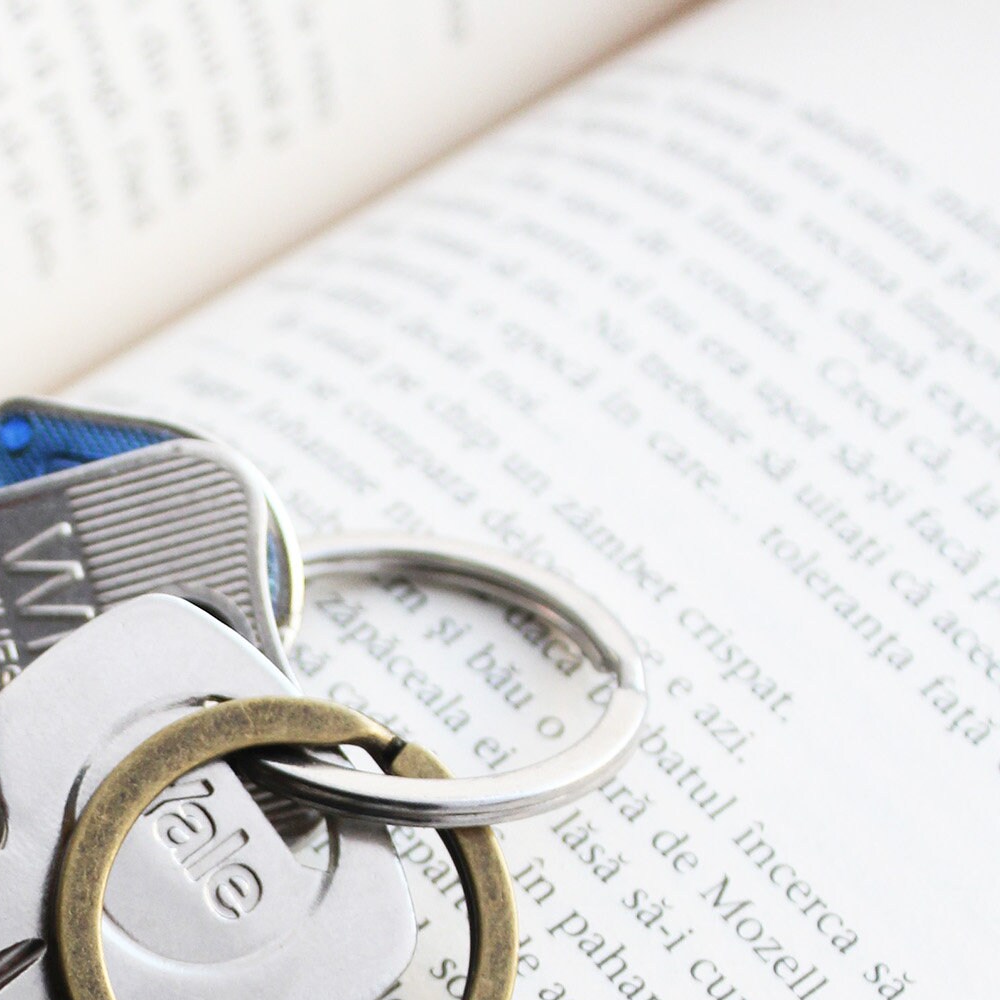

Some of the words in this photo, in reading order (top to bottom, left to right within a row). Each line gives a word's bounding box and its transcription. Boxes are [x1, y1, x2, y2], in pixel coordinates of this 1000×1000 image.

[887, 570, 935, 609] că
[905, 508, 981, 577] facă
[550, 498, 679, 606] zâmbet
[676, 607, 794, 724] crispat.
[757, 524, 915, 673] toleranţa
[918, 675, 998, 748] faţă
[314, 590, 472, 734] zăpăceala
[472, 736, 518, 772] ei
[549, 808, 626, 885] lăsă
[620, 888, 694, 953] să-i
[422, 618, 466, 648] şi
[464, 643, 534, 712] bău
[534, 715, 567, 741] o
[650, 830, 700, 873] de
[665, 676, 694, 698] e
[692, 708, 755, 765] azi.
[512, 857, 557, 906] în
[731, 821, 860, 955] încerca
